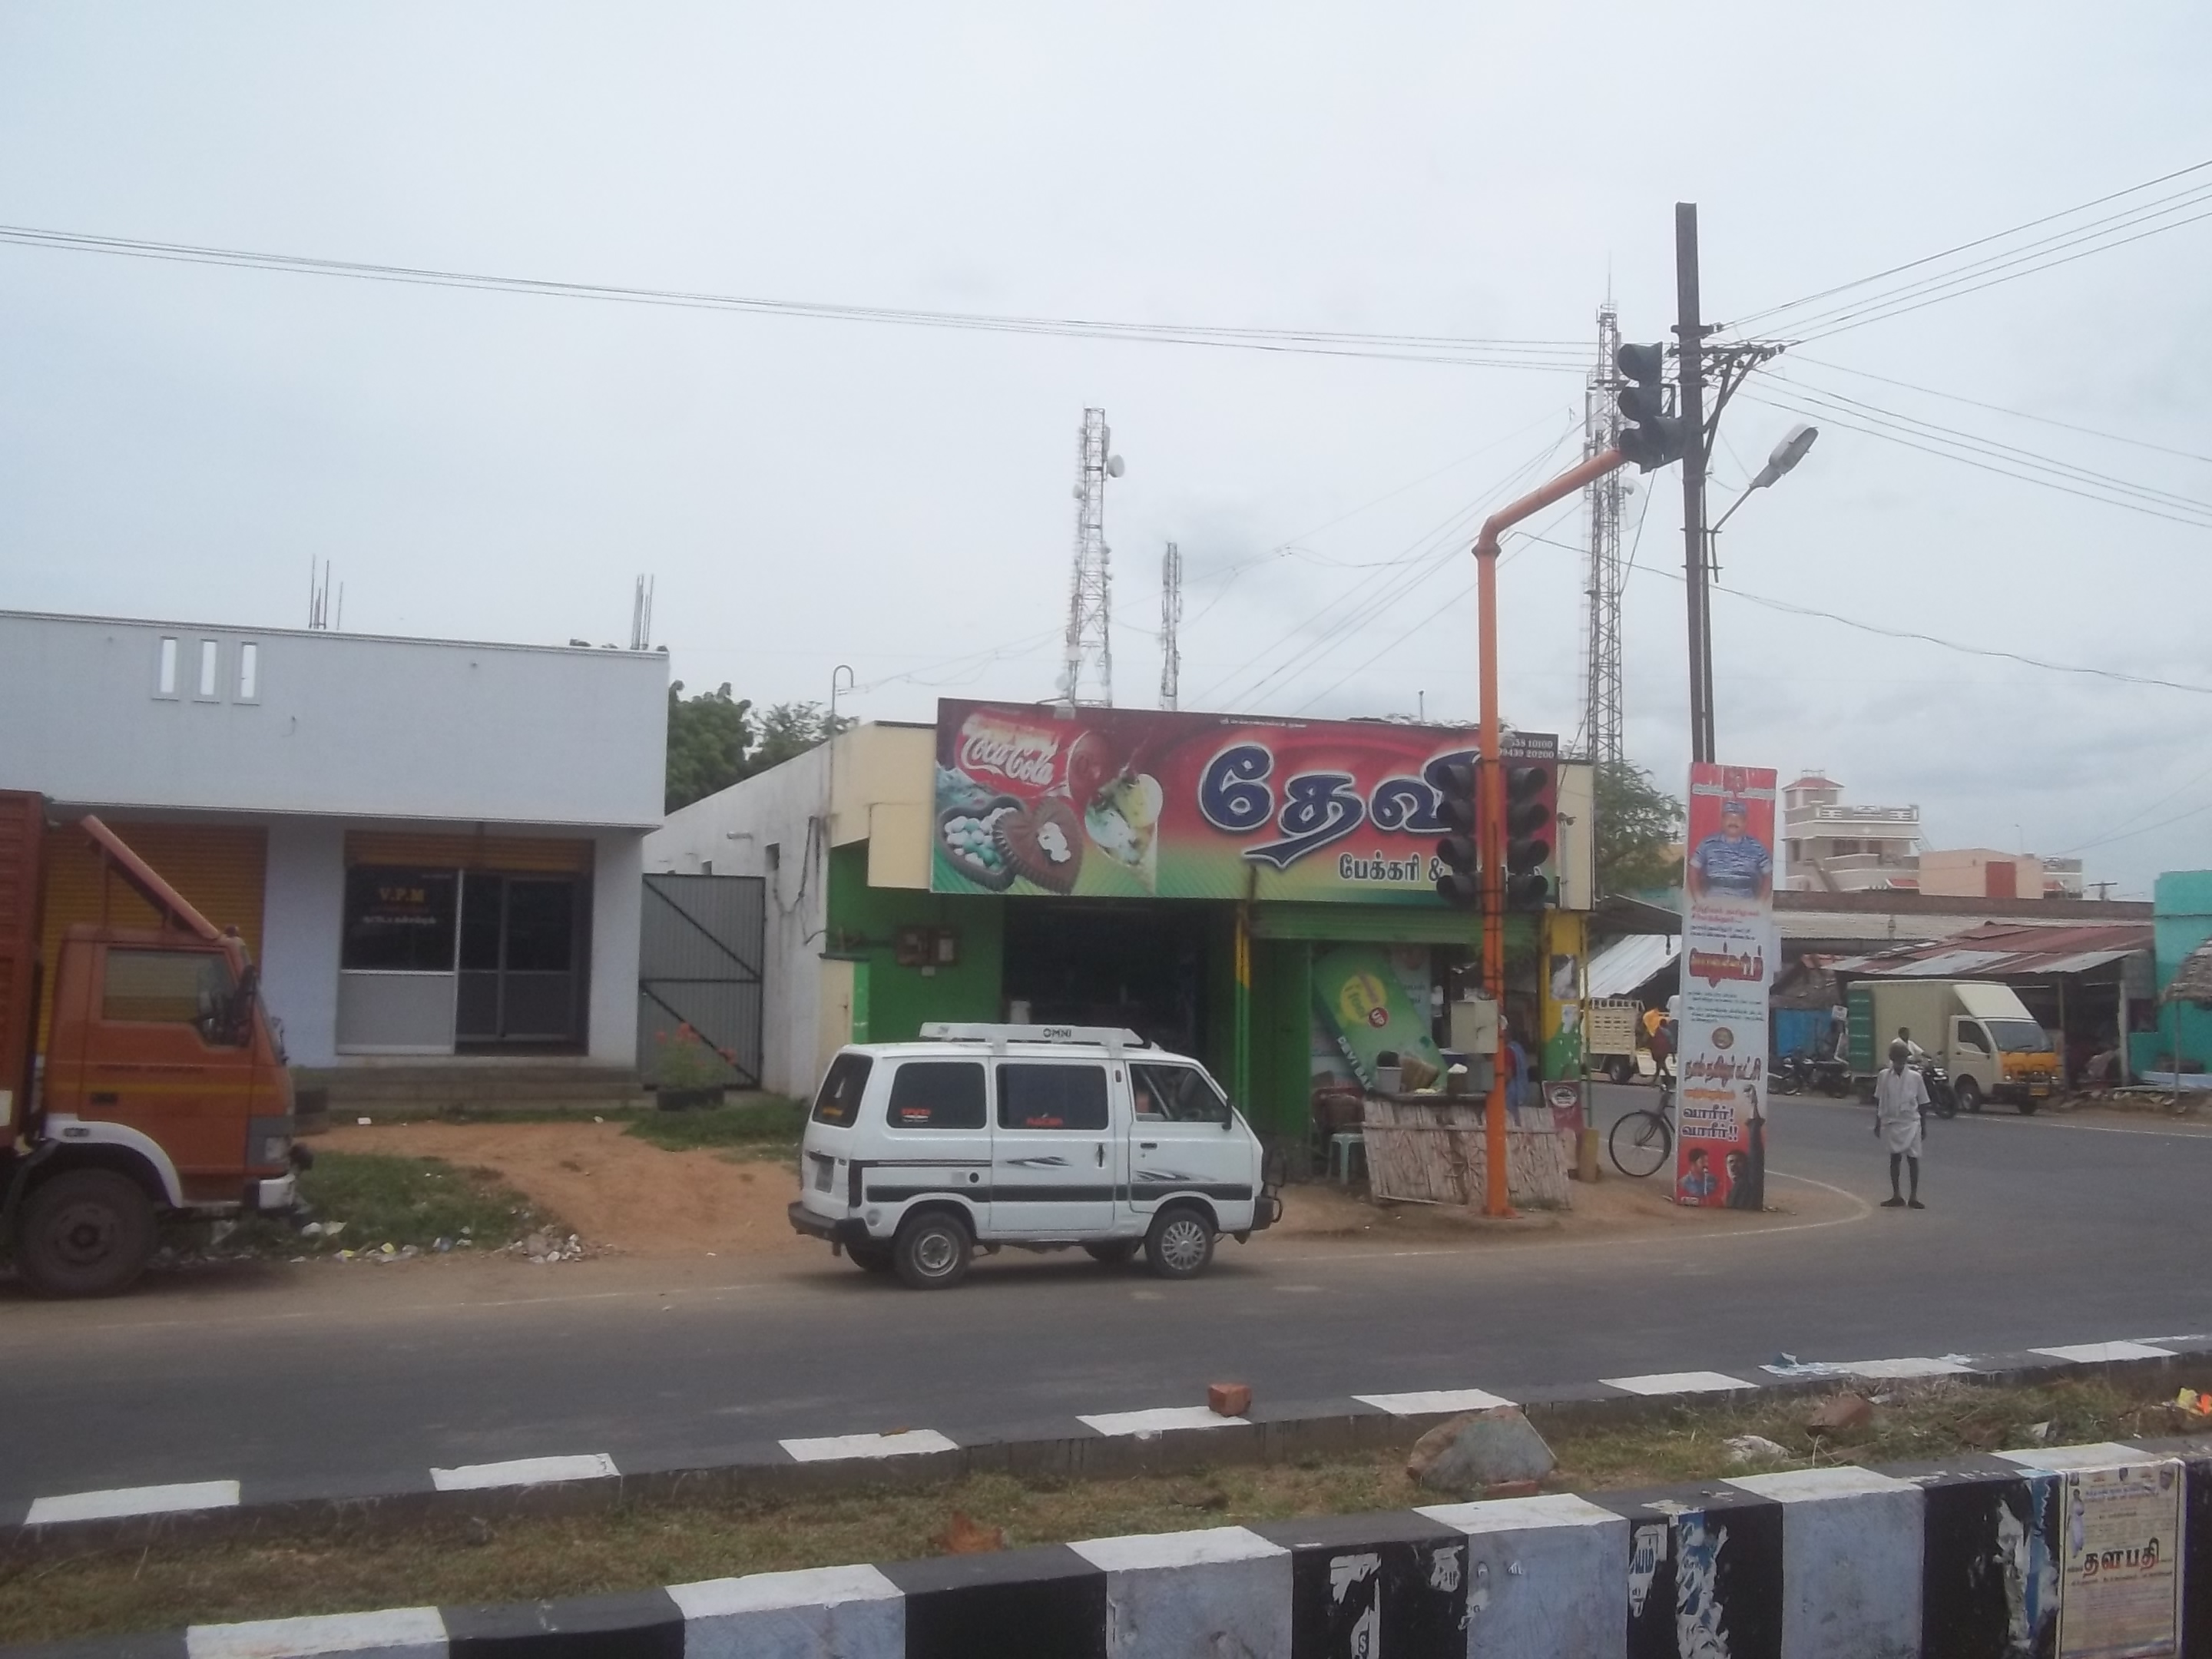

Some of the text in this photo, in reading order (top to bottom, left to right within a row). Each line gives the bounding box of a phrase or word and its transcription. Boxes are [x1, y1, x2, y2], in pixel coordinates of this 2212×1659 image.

[1339, 850, 1420, 882] பேக்கரி
[1043, 1028, 1072, 1038] OMNI
[2082, 1537, 2160, 1578] தளபதி
